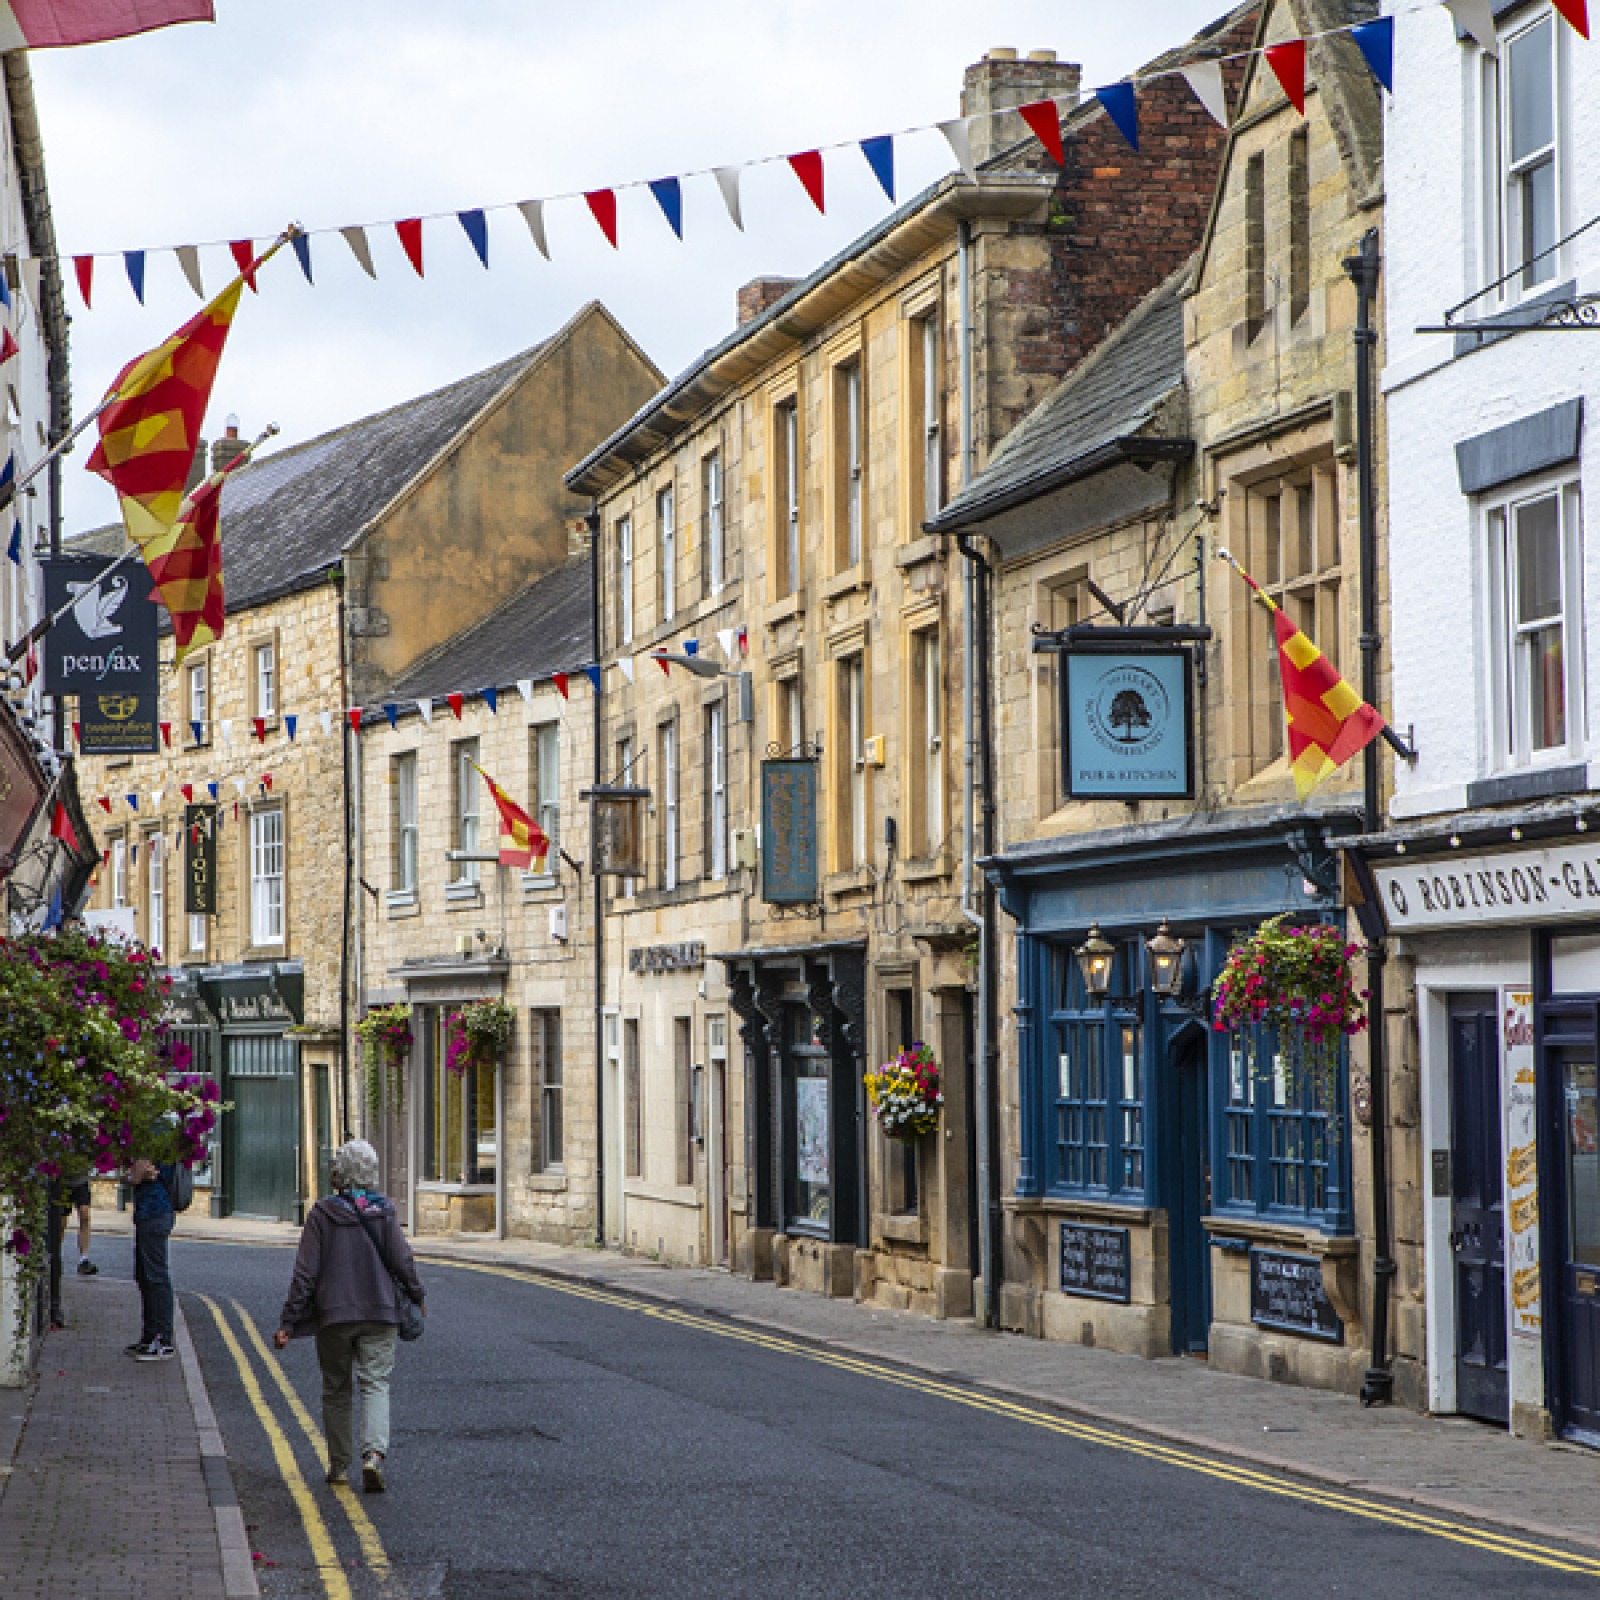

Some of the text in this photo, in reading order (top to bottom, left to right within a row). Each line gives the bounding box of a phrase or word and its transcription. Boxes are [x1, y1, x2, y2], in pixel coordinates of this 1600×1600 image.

[61, 645, 141, 681] penfax
[1079, 769, 1178, 781] PUB & KITCHEN
[1417, 857, 1600, 913] ROBINSON-GA
